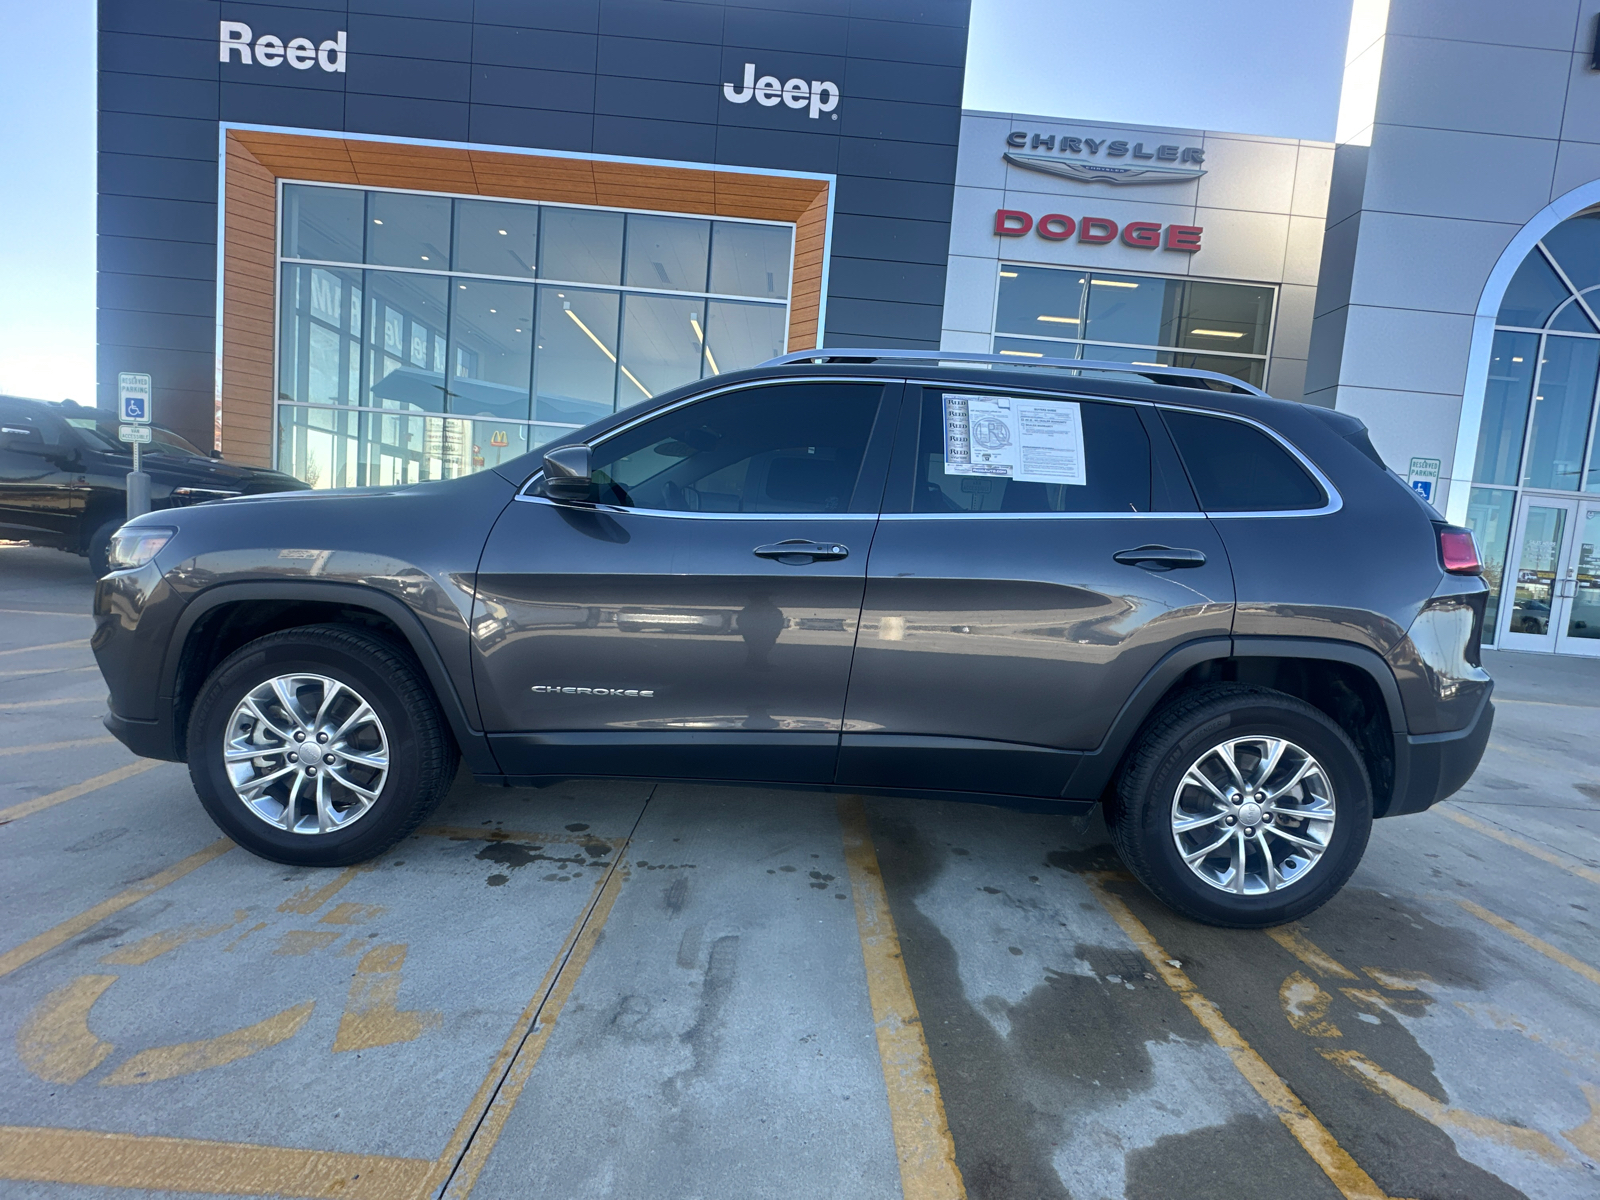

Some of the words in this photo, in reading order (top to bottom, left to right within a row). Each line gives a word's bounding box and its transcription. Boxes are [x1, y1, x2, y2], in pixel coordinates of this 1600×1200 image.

[219, 21, 347, 73] Reed
[723, 63, 840, 119] Jeep
[1007, 131, 1206, 164] CHRYSLER
[994, 208, 1204, 253] DODGE
[122, 377, 148, 386] RESERVED
[122, 385, 148, 394] PARKING
[1411, 469, 1437, 478] PARKING
[1412, 461, 1438, 470] RESERVED
[531, 685, 655, 697] CHEROKEE
[1187, 720, 1222, 746] DEFENDER
[1149, 748, 1182, 806] MICHELIN
